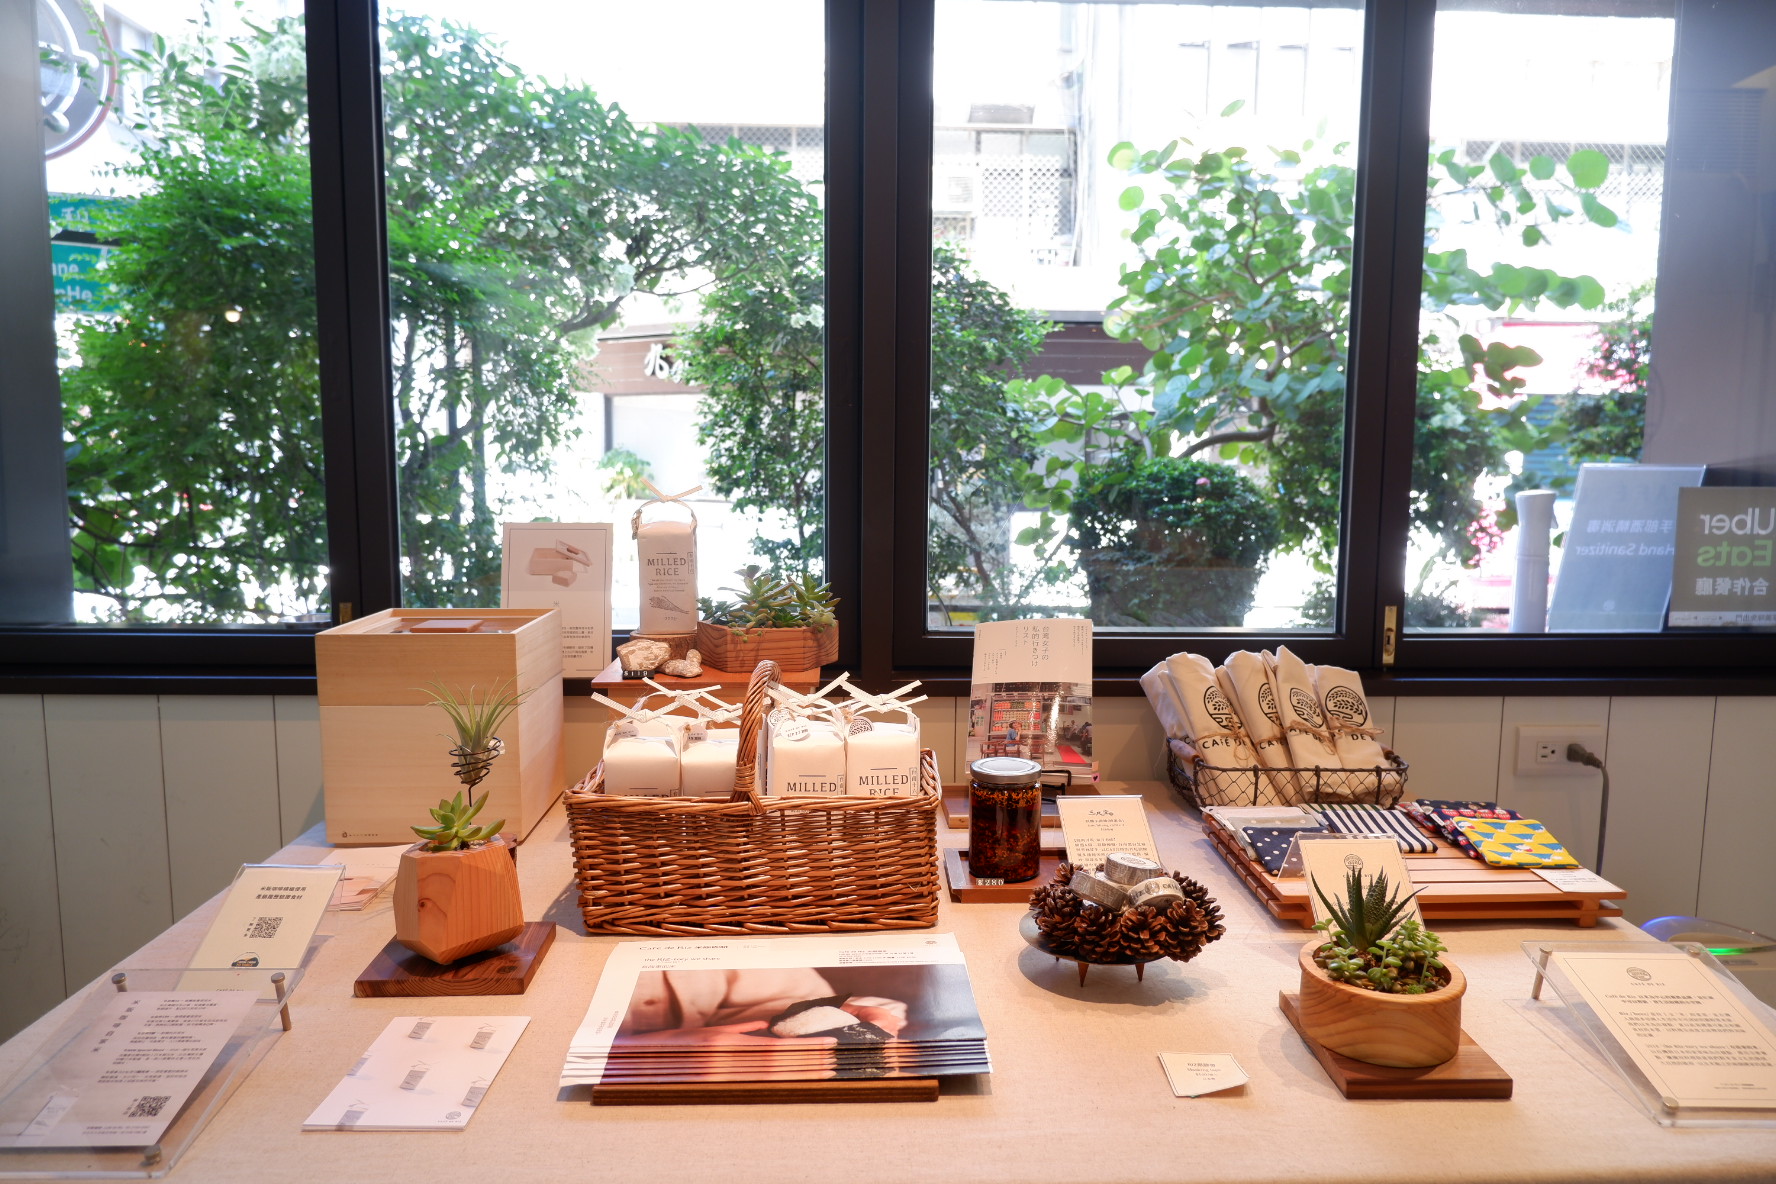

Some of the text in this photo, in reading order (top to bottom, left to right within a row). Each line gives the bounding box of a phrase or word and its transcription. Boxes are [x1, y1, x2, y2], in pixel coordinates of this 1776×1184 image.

[647, 557, 687, 566] MILLED
[655, 567, 680, 576] RICE
[858, 774, 909, 786] MILLED
[786, 782, 837, 793] MILLED
